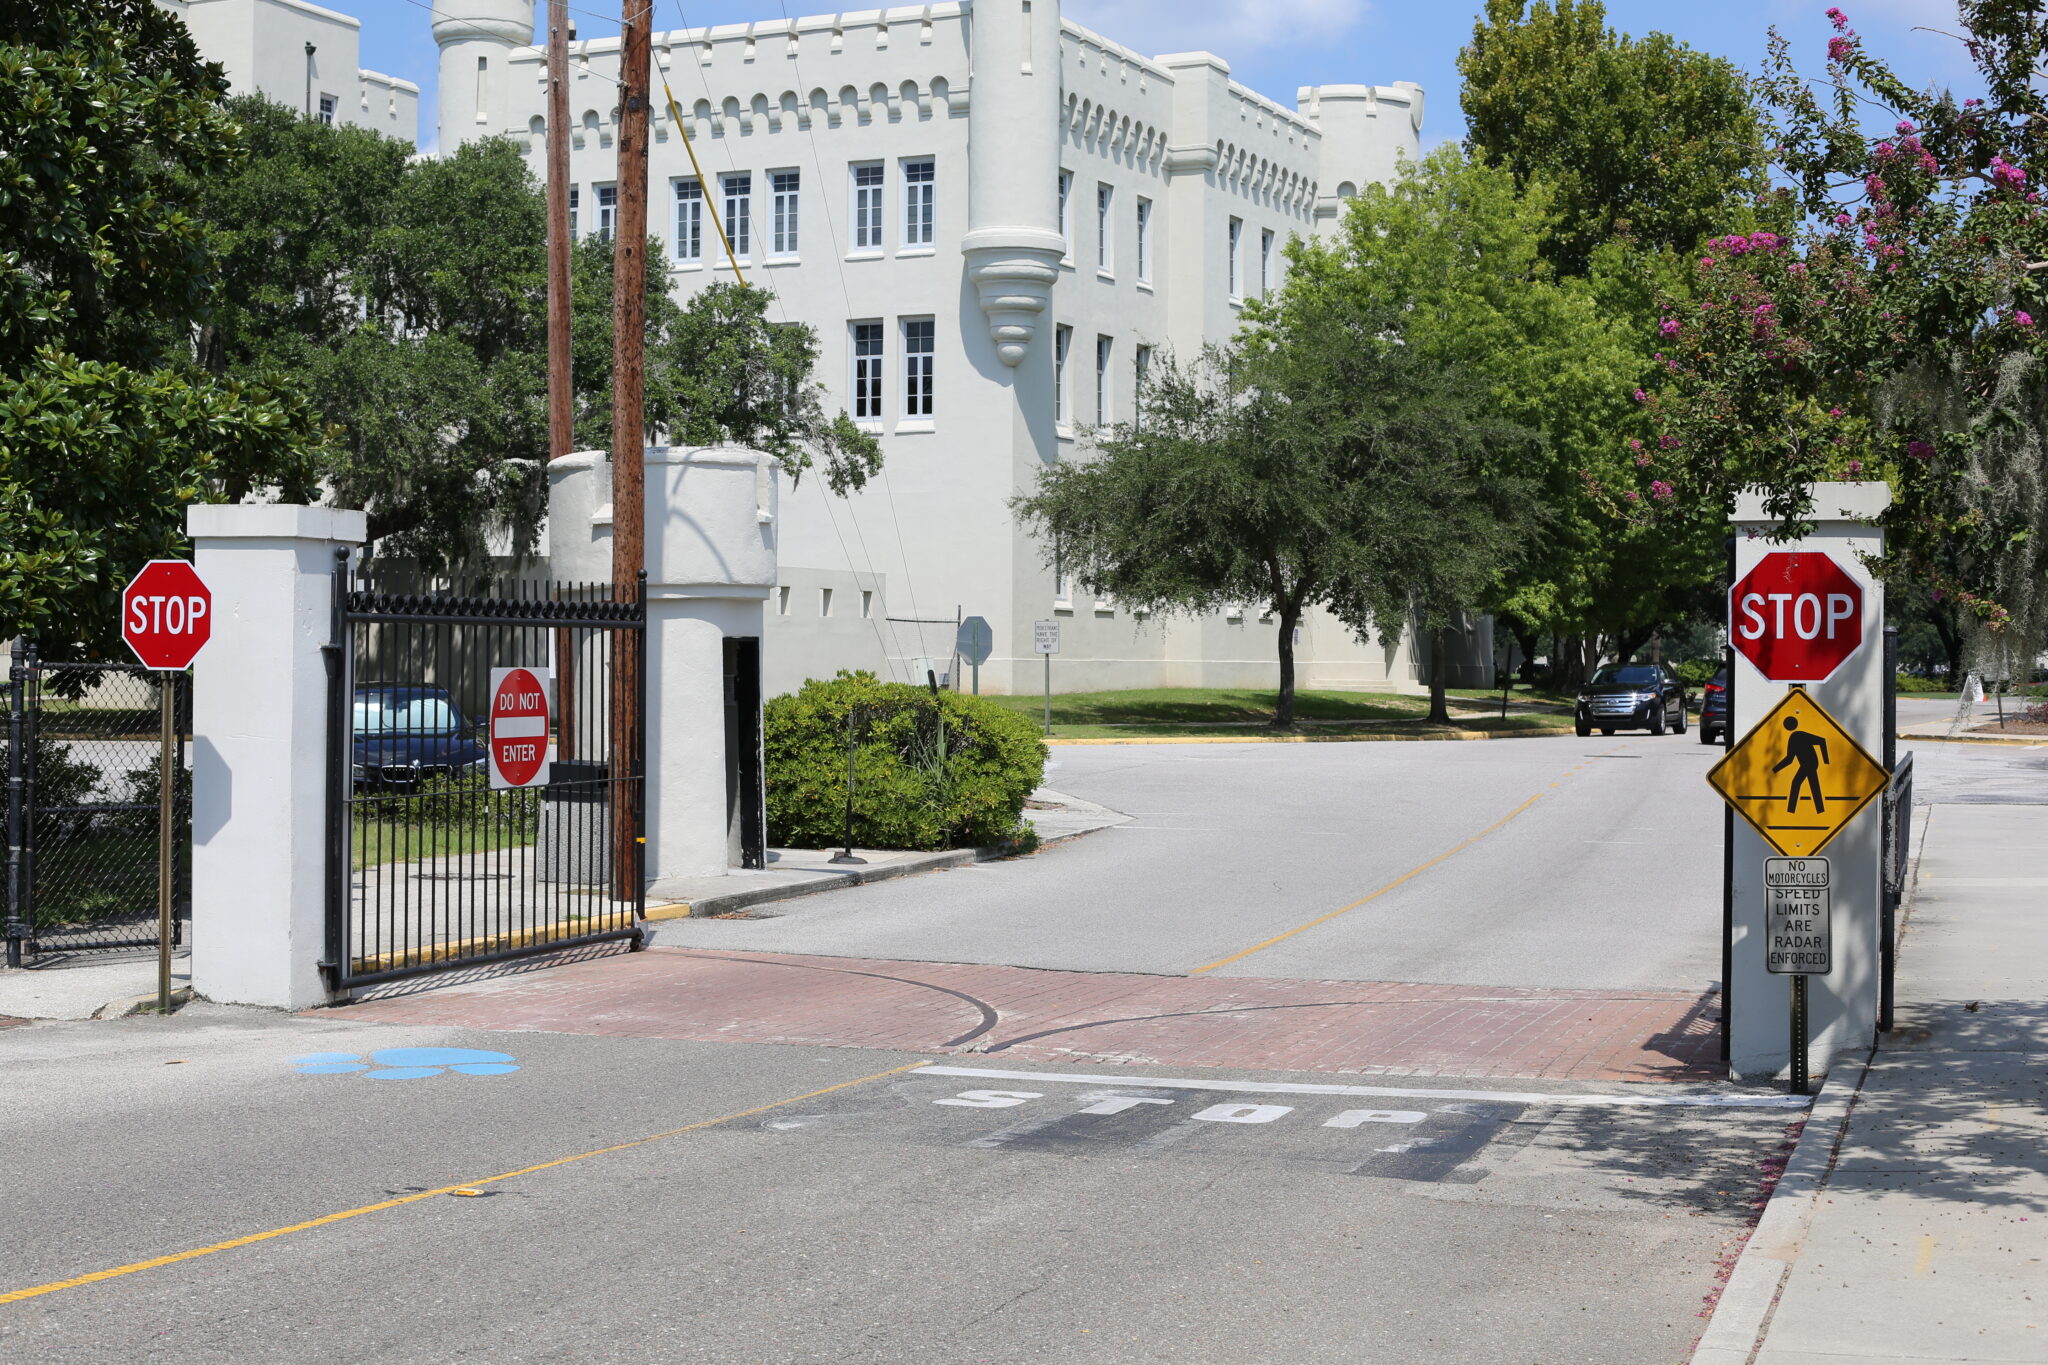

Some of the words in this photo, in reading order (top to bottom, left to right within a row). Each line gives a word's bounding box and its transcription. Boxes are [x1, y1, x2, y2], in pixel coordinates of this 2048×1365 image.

[129, 595, 207, 635] STOP
[1739, 592, 1854, 641] STOP
[500, 693, 514, 711] DO
[519, 692, 540, 710] NOT
[503, 743, 536, 763] ENTER
[1788, 861, 1806, 872] NO
[1768, 872, 1827, 884] MOTORCYCLES
[1775, 889, 1821, 899] SPEED
[1776, 903, 1820, 916] LIMITS
[1784, 920, 1812, 932] ARE
[1774, 936, 1822, 948] RADAR
[1770, 952, 1827, 965] ENFORCED
[932, 1089, 1428, 1128] STOP
